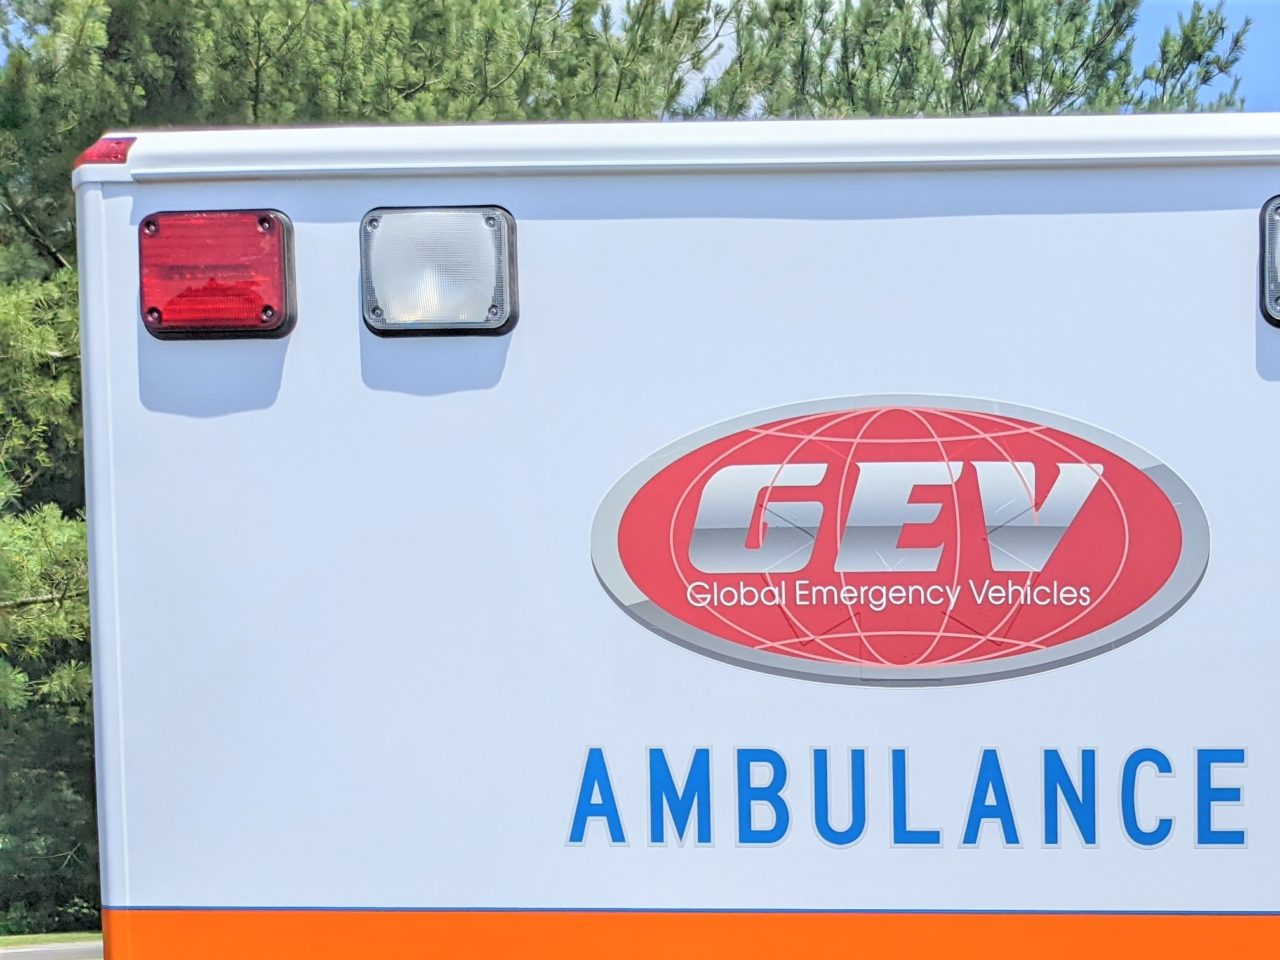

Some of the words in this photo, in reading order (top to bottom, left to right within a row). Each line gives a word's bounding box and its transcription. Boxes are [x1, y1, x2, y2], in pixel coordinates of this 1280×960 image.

[688, 461, 1104, 574] GEV
[686, 580, 786, 607] Global
[795, 580, 961, 611] Emergency
[969, 579, 1092, 607] Vehicles
[569, 747, 1245, 846] AMBULANCE
